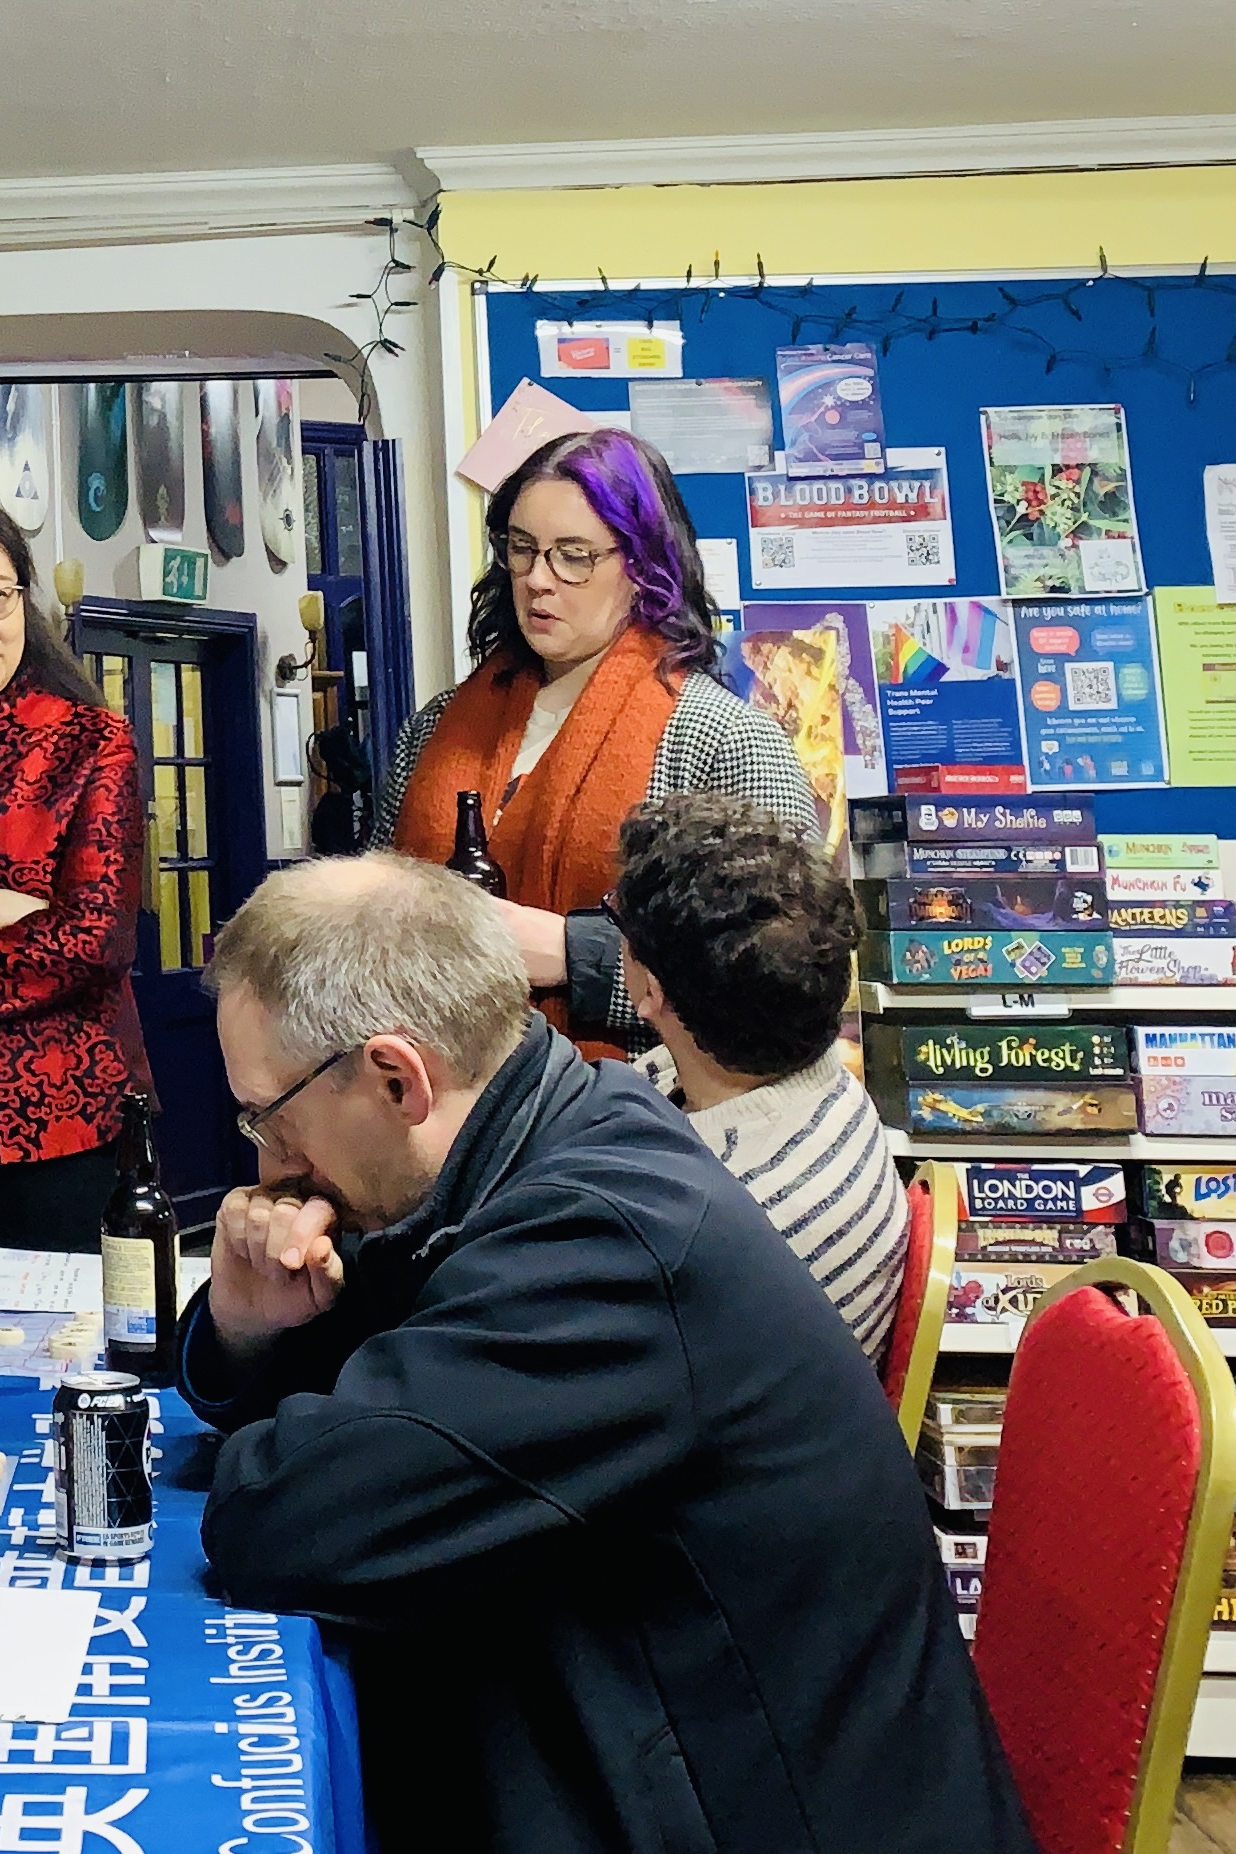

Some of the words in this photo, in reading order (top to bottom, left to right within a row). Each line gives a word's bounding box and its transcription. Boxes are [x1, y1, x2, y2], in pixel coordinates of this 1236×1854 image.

[754, 480, 848, 507] BLOOD
[853, 477, 940, 505] BOWL
[804, 510, 826, 519] GAME
[827, 510, 837, 518] OF
[837, 509, 870, 518] FANTASY
[870, 508, 908, 518] FOOTBALL
[1021, 605, 1040, 619] Are
[1042, 606, 1065, 621] you
[1067, 603, 1091, 618] safe
[886, 690, 909, 698] Trans
[909, 689, 939, 697] Mental
[886, 699, 915, 707] Health
[887, 708, 921, 717] Support
[962, 807, 991, 830] My
[994, 805, 1048, 830] Shelfie
[913, 847, 954, 861] MUNCHKIN
[1125, 841, 1173, 856] MUNCHKIN
[1136, 943, 1178, 964] Little
[1163, 958, 1202, 979] Shop
[1145, 1032, 1236, 1049] MANHATTAN
[996, 1035, 1084, 1072] Forest
[973, 1178, 1077, 1199] LONDON
[974, 1199, 1027, 1211] BOARD
[1034, 1199, 1077, 1212] GAME
[1005, 1274, 1044, 1288] Lords
